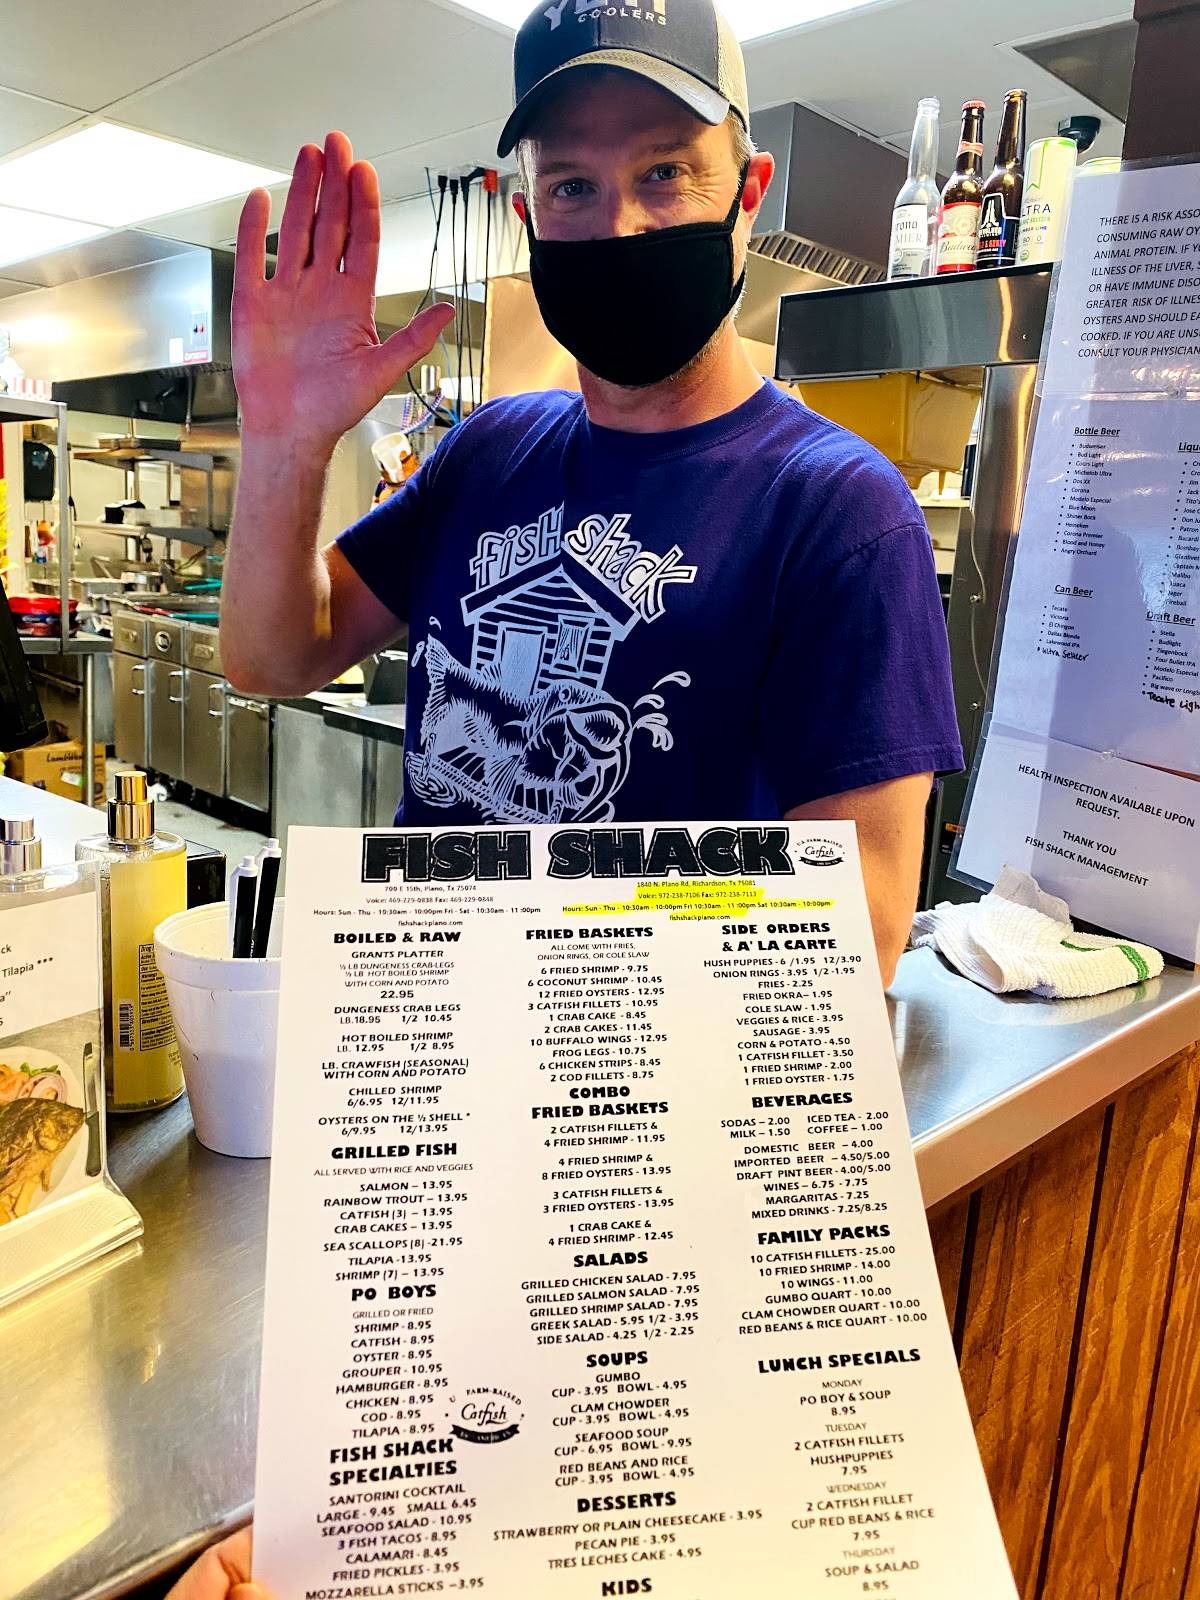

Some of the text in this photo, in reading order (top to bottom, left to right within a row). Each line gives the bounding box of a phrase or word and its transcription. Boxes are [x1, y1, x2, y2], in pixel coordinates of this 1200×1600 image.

[577, 7, 666, 26] COOLERS
[1099, 215, 1129, 226] THERE
[1131, 214, 1140, 224] IS
[1141, 213, 1149, 223] A
[1151, 211, 1173, 222] RISK
[1096, 227, 1184, 243] CONSUMING RAW
[1093, 244, 1190, 260] ANIMAL PROTEIN. IF
[1091, 261, 1194, 276] ILLNESS OF THE LIVER,
[1088, 283, 1102, 293] OR
[1104, 282, 1130, 292] HAVE
[1132, 279, 1175, 290] IMMUNE
[1086, 298, 1128, 309] GREATER
[1132, 297, 1153, 307] RISK
[1155, 296, 1169, 306] OF
[1083, 312, 1188, 325] OYSTERS AND SHOULD
[1080, 329, 1176, 341] COOKED. IF YOU ARE
[1078, 348, 1120, 358] CONSULT
[1122, 347, 1148, 356] YOUR
[1074, 426, 1121, 436] Bottle Beer
[1055, 584, 1093, 596] Can Beer
[1146, 610, 1196, 624] Draft Beer
[1156, 648, 1188, 657] Ziegenbock
[1152, 674, 1173, 682] Pacifico
[1153, 665, 1199, 677] Modelo Especial
[1018, 764, 1195, 827] HEALTH INSPECTION AVAILABLE UPON
[1075, 797, 1121, 820] REQUEST.
[1063, 830, 1117, 856] THANK YOU
[361, 827, 796, 883] FISH SHACK
[1025, 836, 1149, 886] FISH SHACK MANAGEMENT
[526, 927, 653, 940] FRIED BASKETS
[722, 922, 830, 935] SIDE ORDERS
[334, 932, 461, 944] BOILED & RAW
[722, 942, 733, 952] &
[758, 940, 780, 951] LA
[784, 939, 837, 950] CARTE
[397, 950, 444, 958] PLATTER
[1, 963, 34, 978] Tilapia
[380, 990, 414, 999] 22.95
[569, 1086, 630, 1099] COMBO
[752, 1092, 853, 1108] BEVERAGES
[532, 1101, 669, 1119] FRIED BASKETS
[331, 1143, 457, 1159] GRILLED FISH
[436, 1163, 473, 1171] VEGGIES
[758, 1224, 890, 1245] FAMILY PACKS
[574, 1251, 648, 1268] SALADS
[351, 1284, 436, 1301] PO BOYS
[586, 1351, 648, 1368] SOUPS
[758, 1348, 921, 1373] LUNCH SPECIALS
[596, 1371, 640, 1383] GUMBO
[822, 1379, 862, 1388] MONDAY
[571, 1398, 669, 1413] CLAM CHOWDER
[831, 1406, 856, 1416] 8.95
[461, 1401, 508, 1427] Catfish
[575, 1427, 669, 1443] SEAFOOD SOUP
[825, 1423, 866, 1432] TUESDAY
[330, 1438, 453, 1464] FISH SHACK
[810, 1450, 893, 1465] HUSHPUPPIES
[329, 1460, 457, 1486] SPECIALTIES
[842, 1465, 867, 1475] 7.95
[826, 1481, 886, 1493] WEDNESDAY
[330, 1484, 465, 1506] SANTORINI COCKTAIL
[577, 1491, 676, 1513] DESSERTS
[602, 1578, 652, 1597] KIDS
